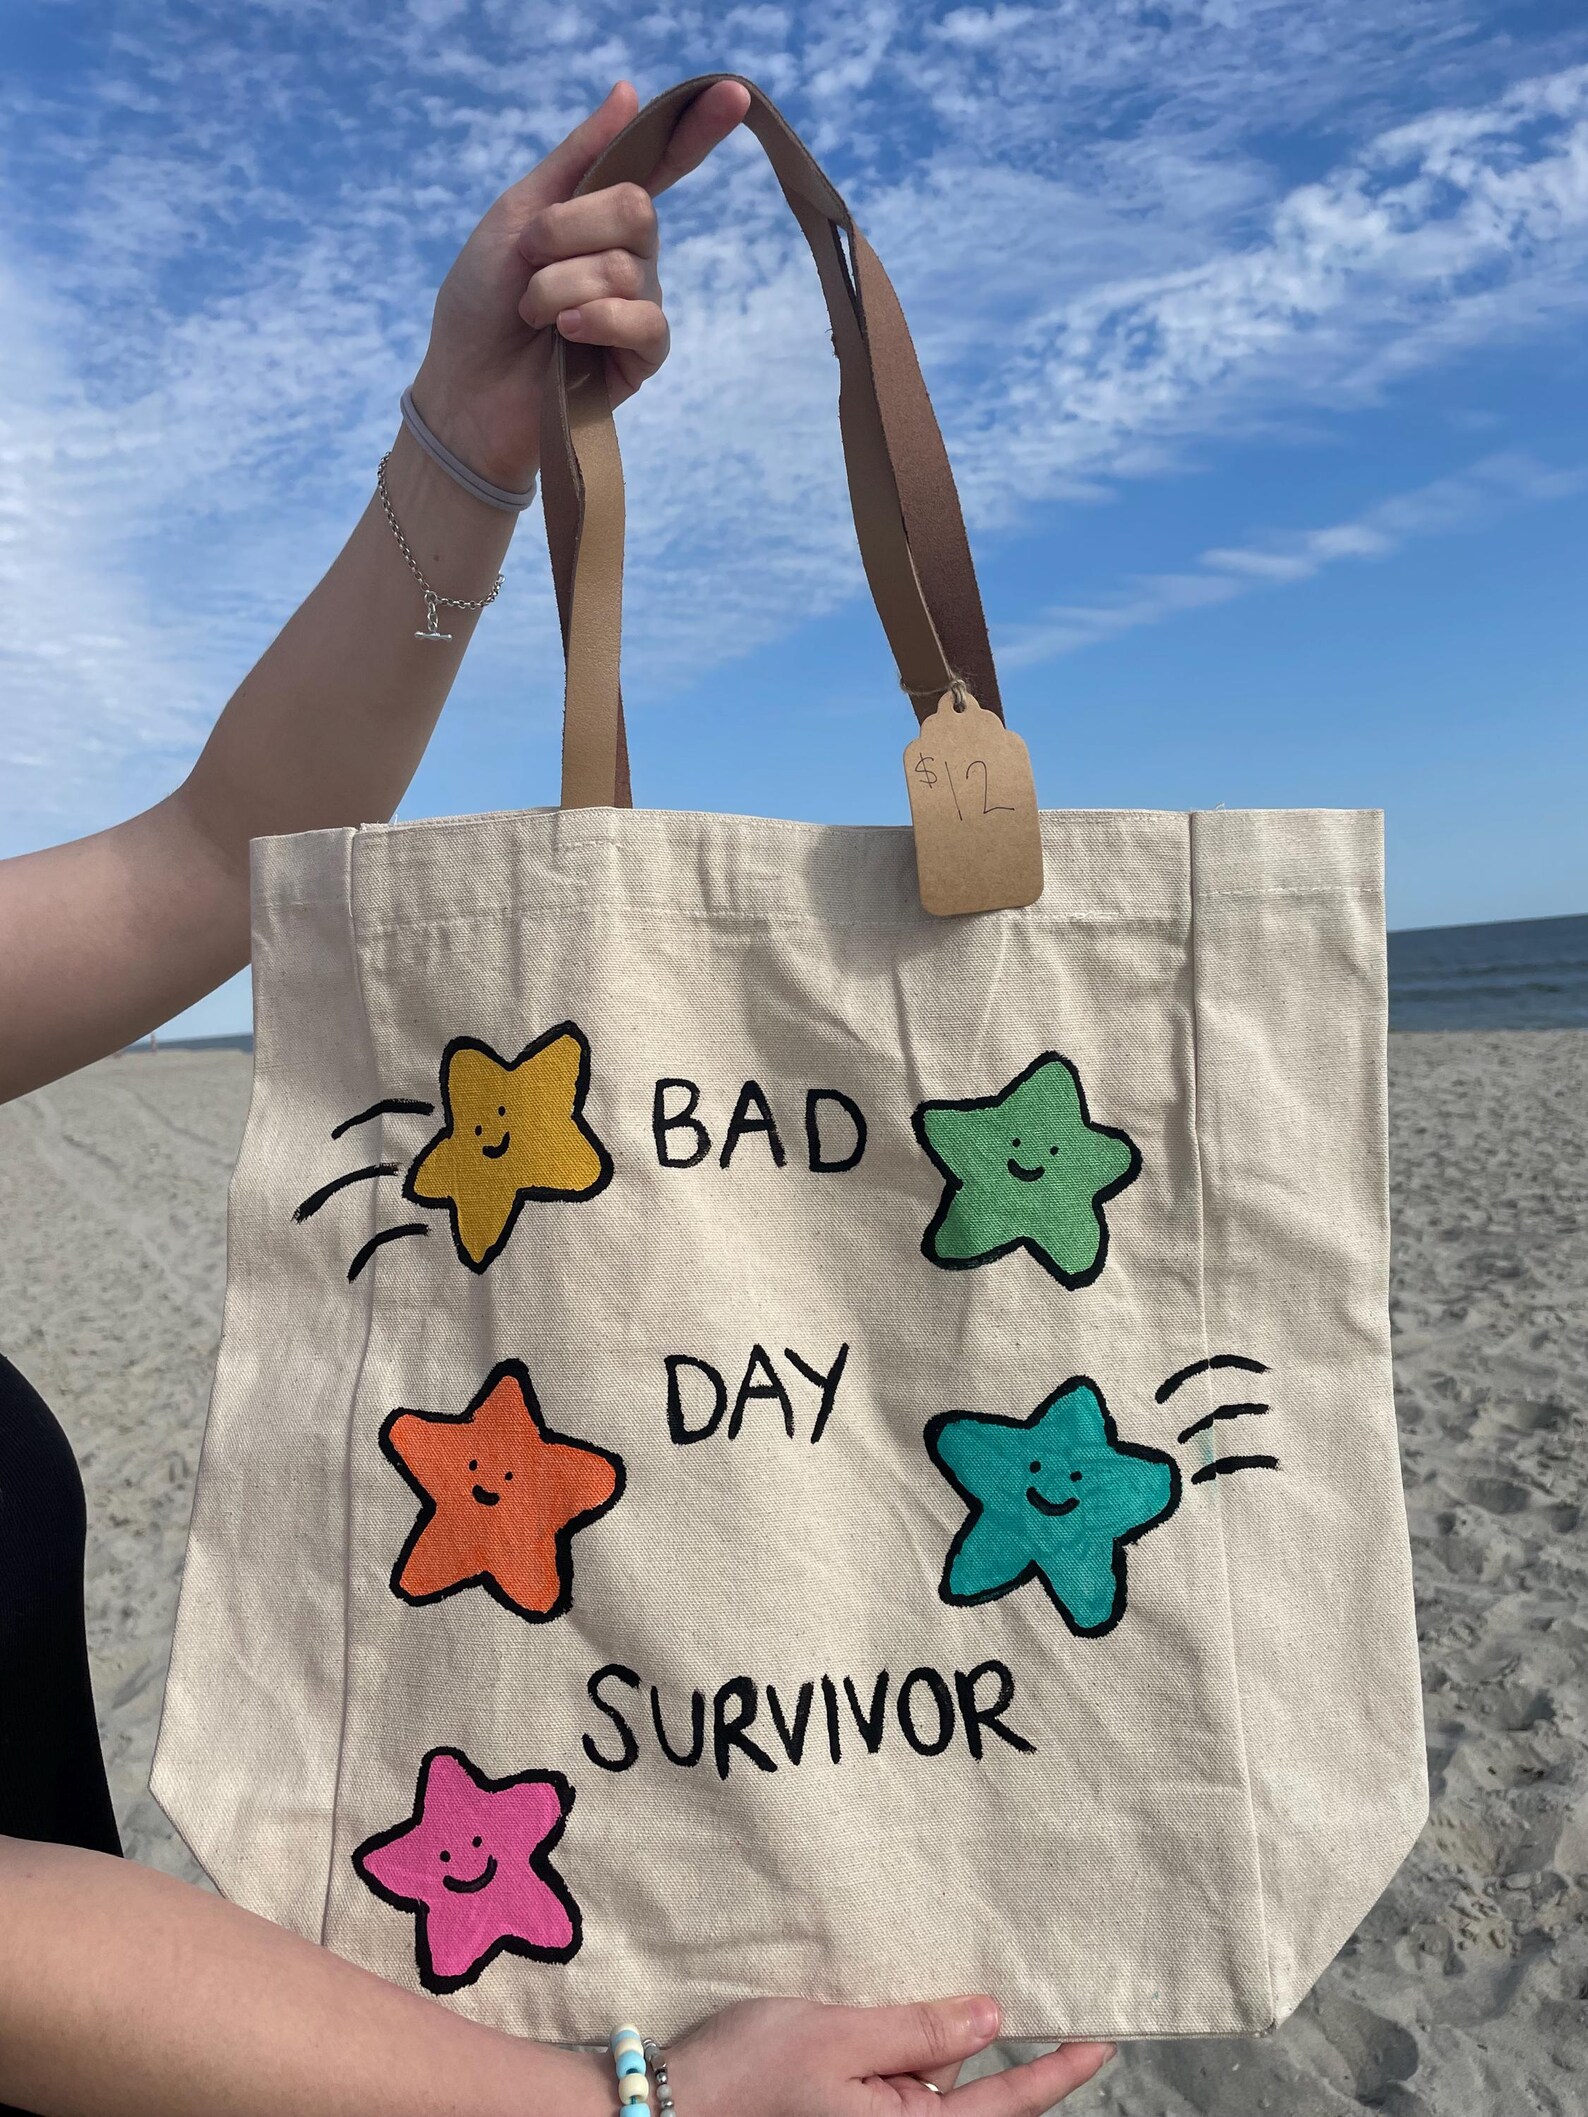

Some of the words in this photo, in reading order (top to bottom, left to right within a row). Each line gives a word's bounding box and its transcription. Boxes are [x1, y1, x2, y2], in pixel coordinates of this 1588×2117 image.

[914, 752, 1015, 822] $12
[652, 1077, 868, 1174] BAD
[663, 1342, 850, 1446] DAY
[581, 1659, 1038, 1782] SURVIVOR
